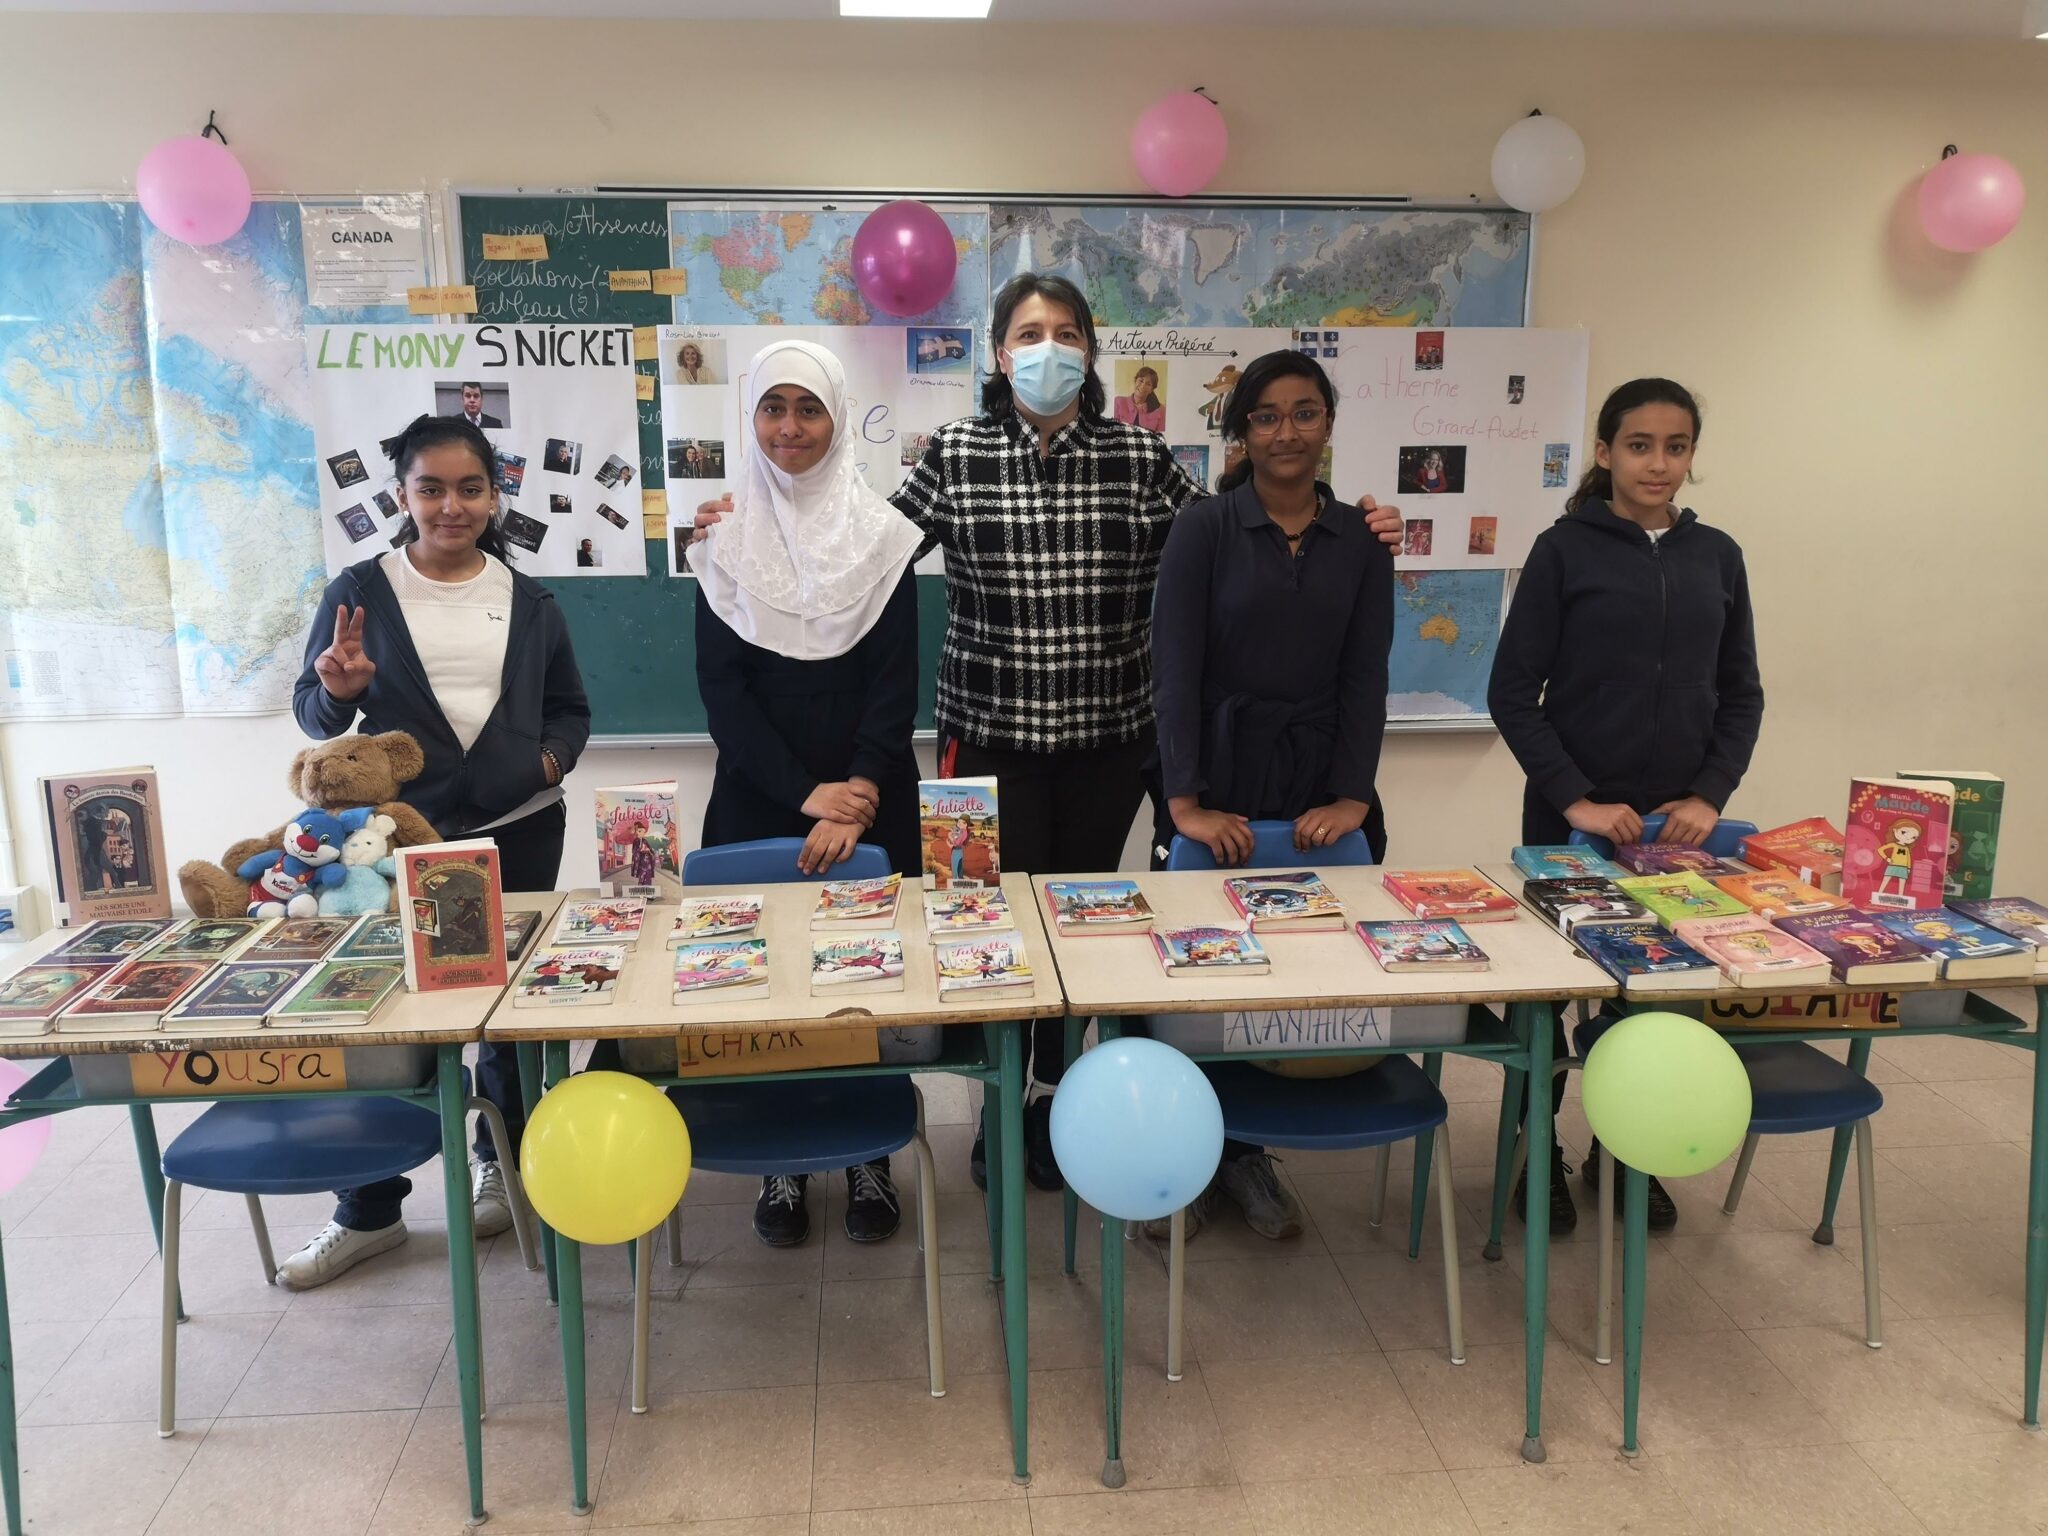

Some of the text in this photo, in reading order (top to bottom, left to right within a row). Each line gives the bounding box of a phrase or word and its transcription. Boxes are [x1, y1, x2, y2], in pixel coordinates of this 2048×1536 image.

[331, 232, 394, 244] CANADA
[316, 328, 465, 369] LEMONY
[1107, 330, 1163, 350] Auteur
[1164, 330, 1217, 357] Préféré
[1413, 405, 1542, 440] Girard-Audet
[609, 804, 664, 826] Juliette
[933, 796, 985, 818] Juliette
[1874, 796, 1931, 815] Maude
[89, 909, 126, 919] MAUVAISE
[109, 902, 130, 910] SOUS
